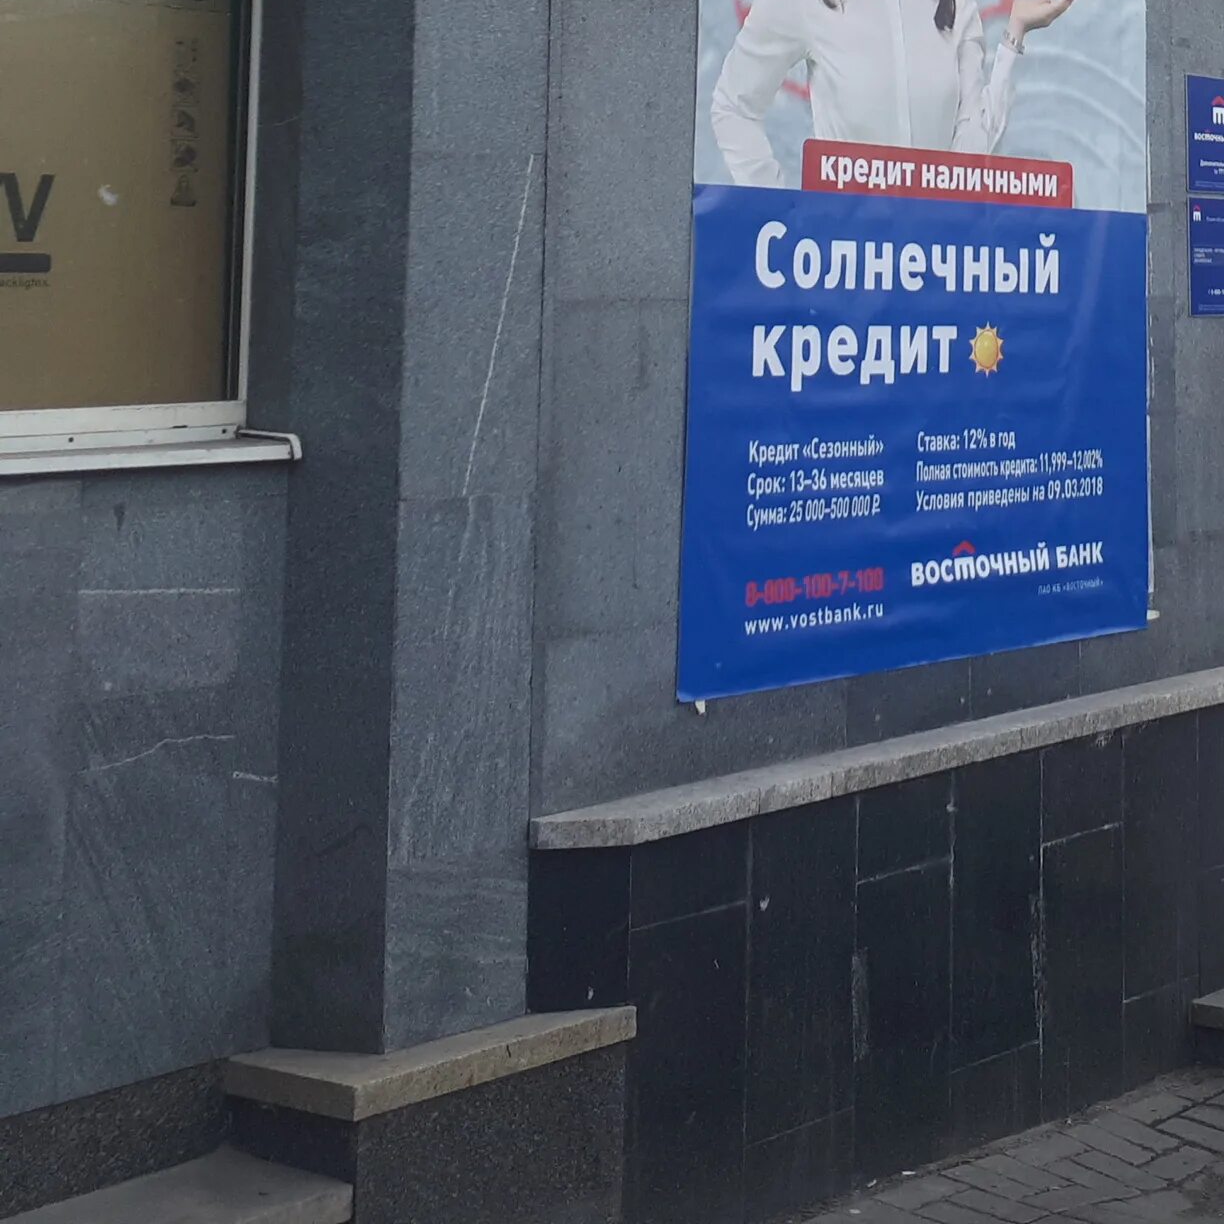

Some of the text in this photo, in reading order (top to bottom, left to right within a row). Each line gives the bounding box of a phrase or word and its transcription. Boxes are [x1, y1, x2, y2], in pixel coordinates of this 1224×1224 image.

[820, 155, 1058, 197] кредит наличными
[755, 221, 1060, 294] Солнечный
[752, 324, 958, 392] кредит
[749, 434, 884, 467] Кредит «Сезонный»
[917, 428, 1016, 452] Ставка: 12% в год
[747, 473, 786, 500] Срок:
[830, 469, 884, 489] месяцев
[916, 461, 950, 482] Полная
[952, 463, 999, 479] стоимость
[1000, 457, 1038, 480] кредита:
[916, 476, 1104, 512] Условия приведены на 09.03.2018
[746, 503, 787, 531] Сумма:
[789, 500, 803, 523] 25
[851, 494, 871, 517] 000
[911, 541, 1104, 587] ВОСТОЧНЫЙ БАНК
[744, 603, 884, 636] www.vostbank.ru
